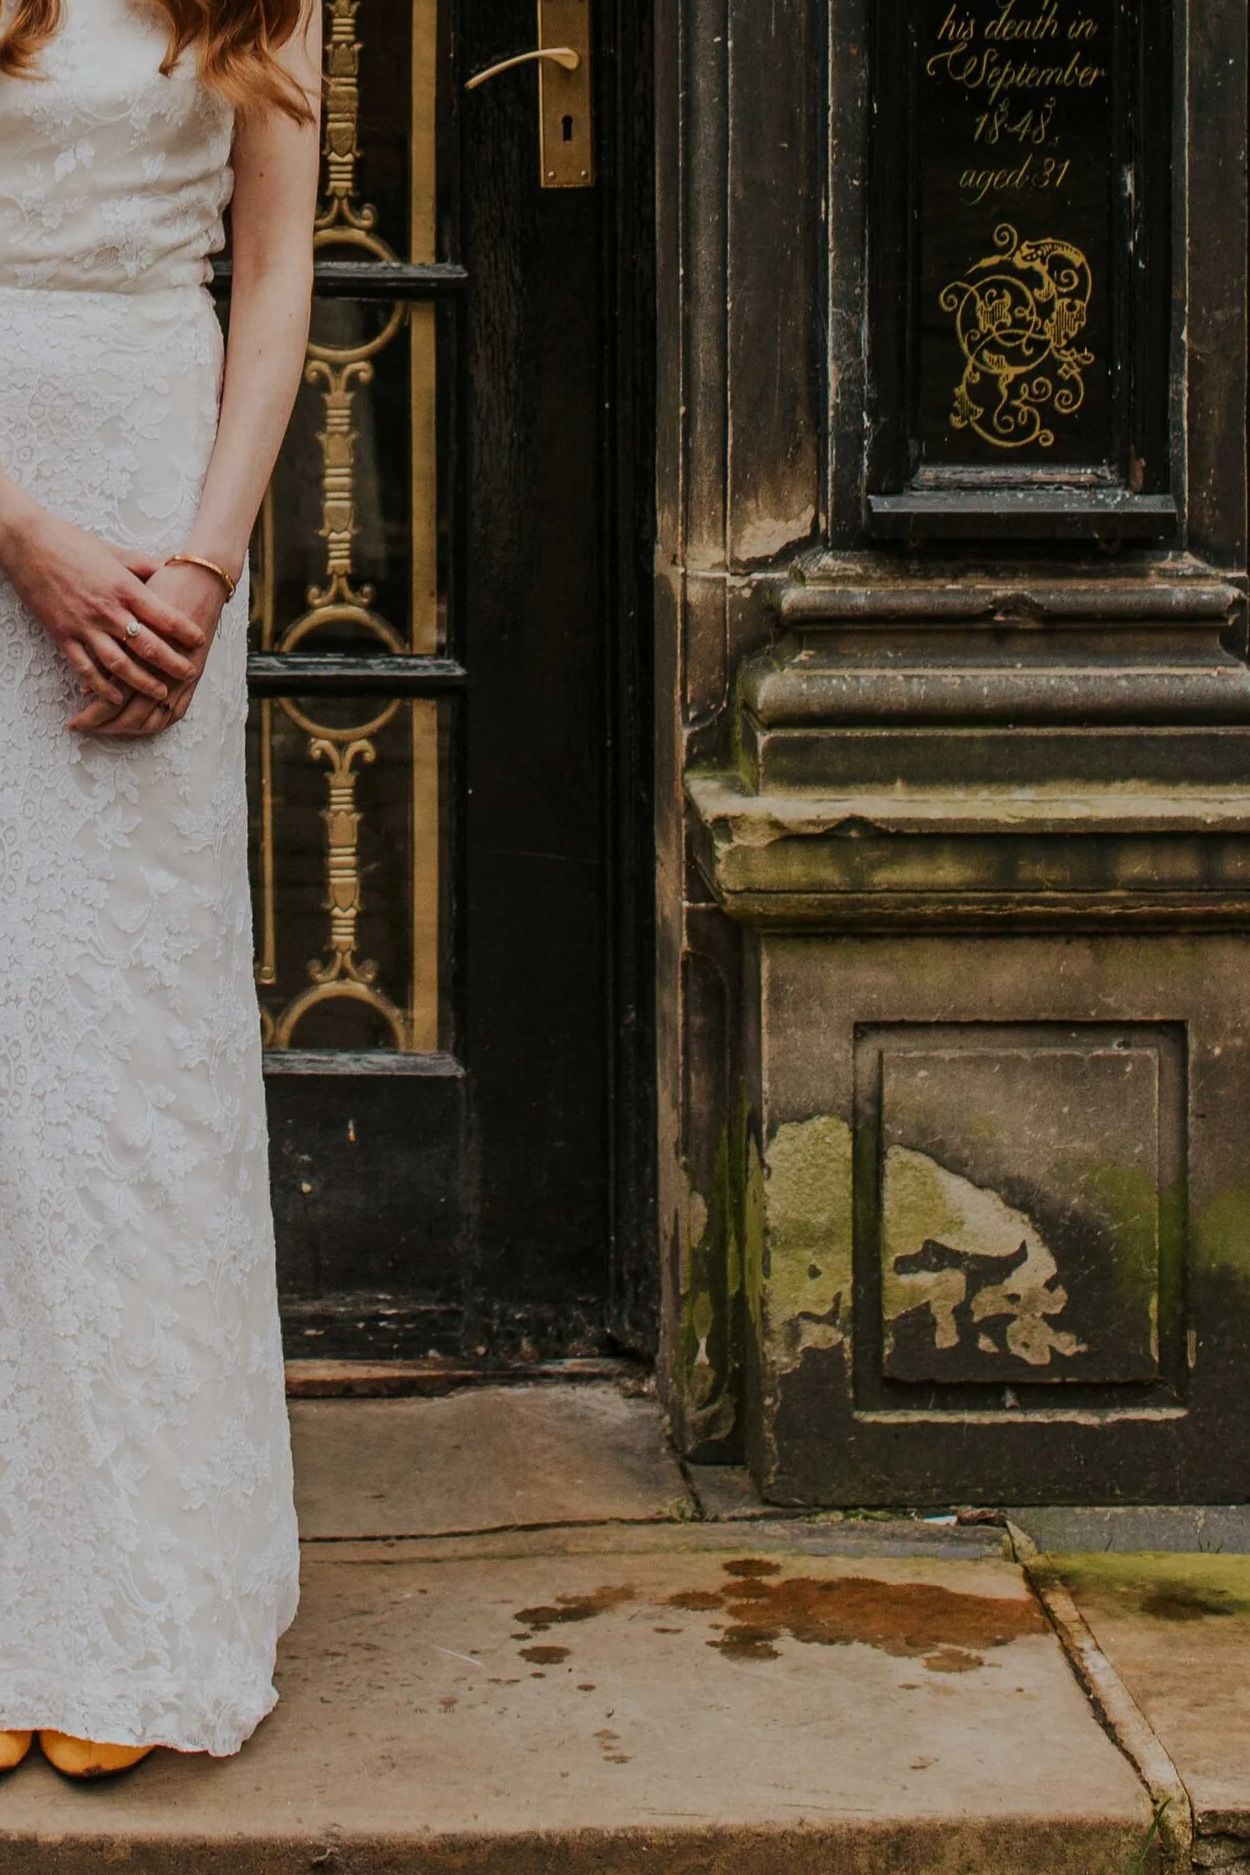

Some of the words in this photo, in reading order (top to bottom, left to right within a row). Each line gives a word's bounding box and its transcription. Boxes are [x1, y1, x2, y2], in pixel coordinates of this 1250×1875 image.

[937, 3, 975, 41] his
[984, 2, 1059, 41] death
[1067, 10, 1098, 40] in
[926, 41, 1107, 106] September
[959, 153, 1030, 206] aged
